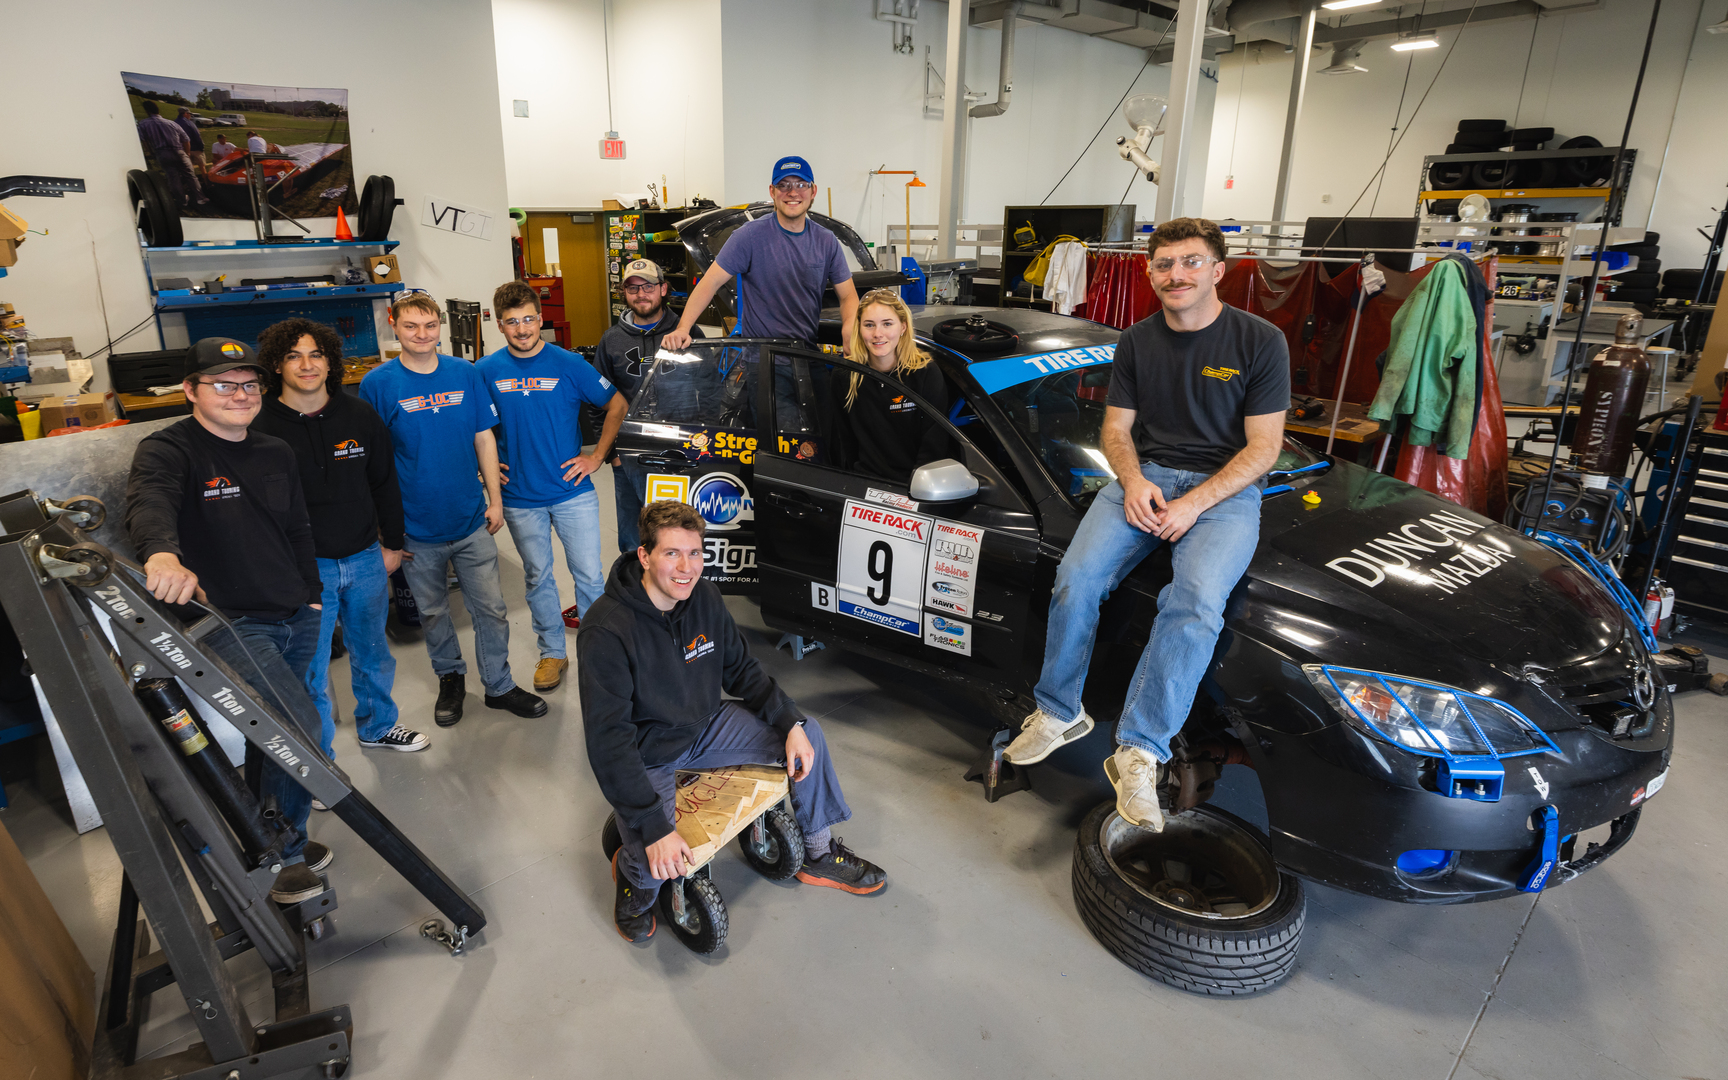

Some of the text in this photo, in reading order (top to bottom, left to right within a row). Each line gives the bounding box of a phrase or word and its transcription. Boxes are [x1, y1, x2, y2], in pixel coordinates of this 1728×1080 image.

[604, 140, 624, 158] EXIT
[1504, 285, 1517, 296] 26
[1023, 346, 1117, 374] TIRE RA
[511, 378, 541, 389] G-LOC
[417, 393, 450, 407] G-LOC
[851, 506, 923, 540] TIRE RACK
[937, 524, 978, 543] TIRE RACK
[1324, 509, 1486, 588] DUNCAN
[866, 540, 893, 606] 9
[1429, 543, 1516, 595] MAZDA
[398, 599, 415, 608] RIG
[818, 587, 829, 607] B
[932, 598, 955, 610] HAWK
[853, 606, 907, 627] ChampCar
